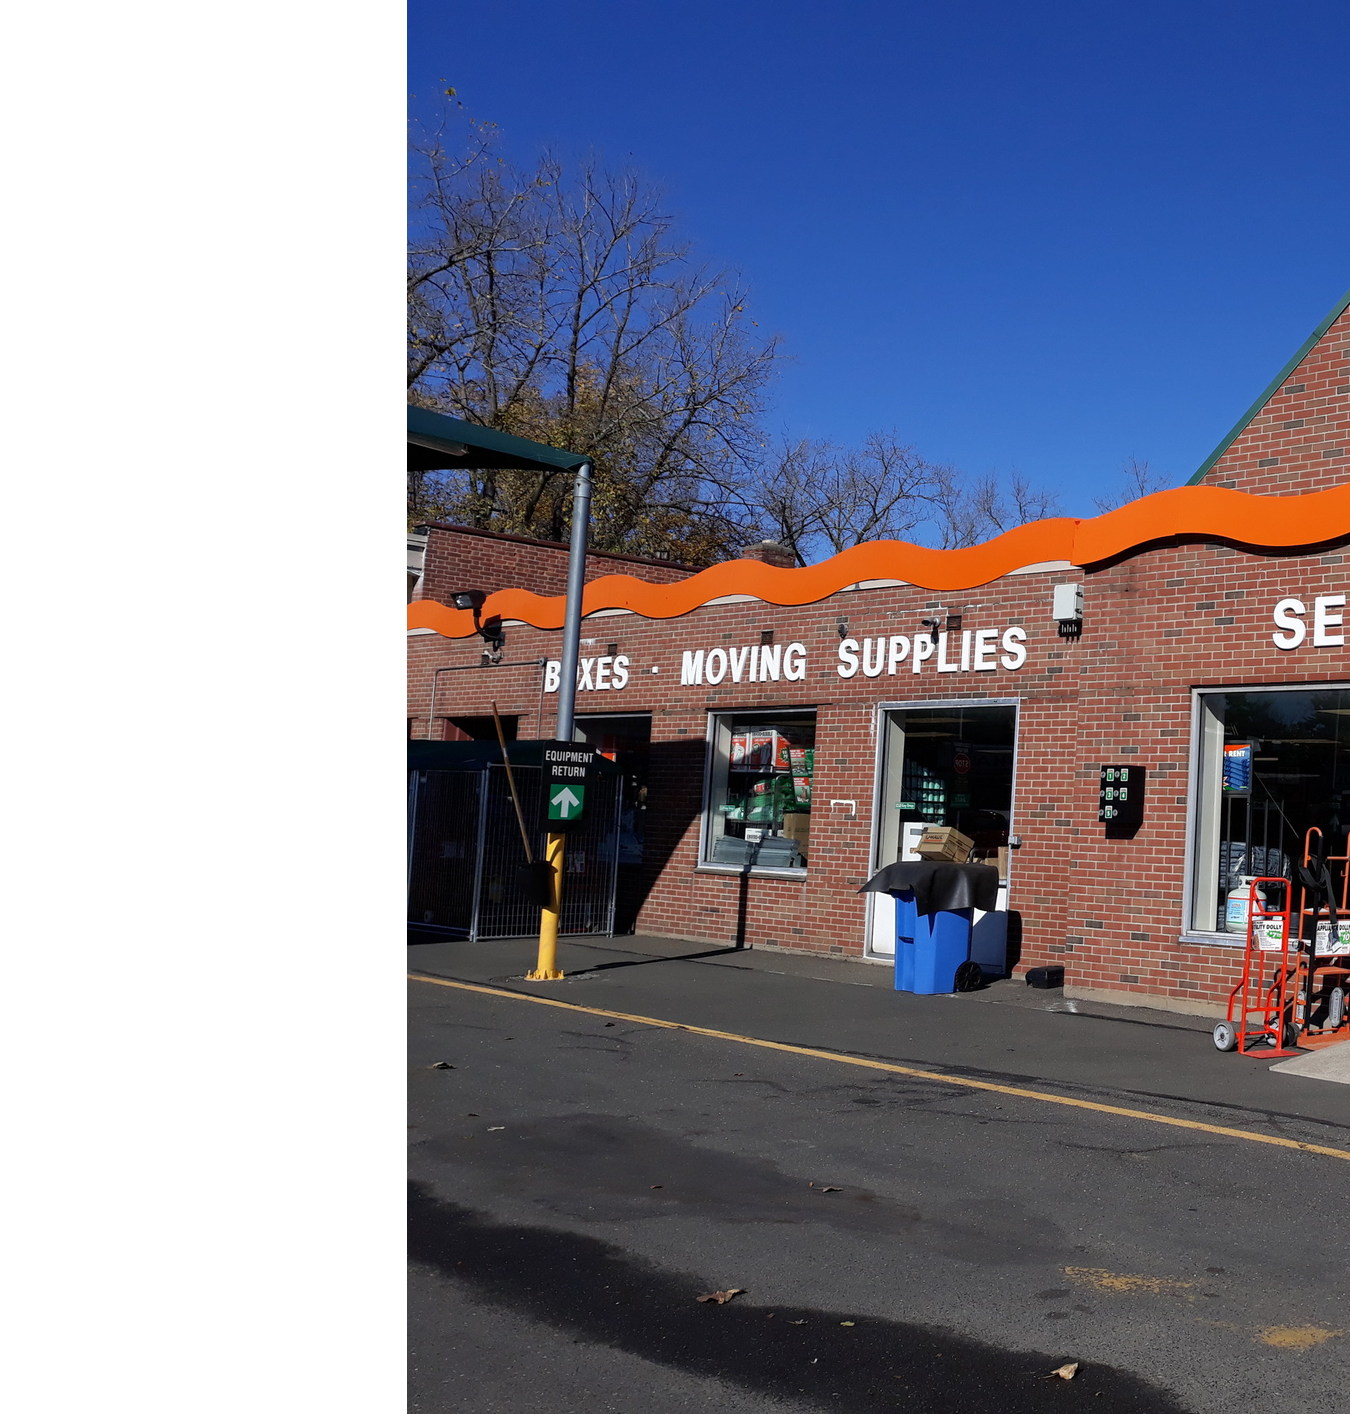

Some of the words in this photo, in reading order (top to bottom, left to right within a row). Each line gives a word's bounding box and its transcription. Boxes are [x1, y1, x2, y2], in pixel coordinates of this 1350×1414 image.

[544, 655, 630, 693] BXES
[681, 642, 806, 686] MOVING
[837, 626, 1027, 680] SUPPLIES
[545, 749, 594, 763] EQUIPMENT
[551, 765, 586, 778] RETURN
